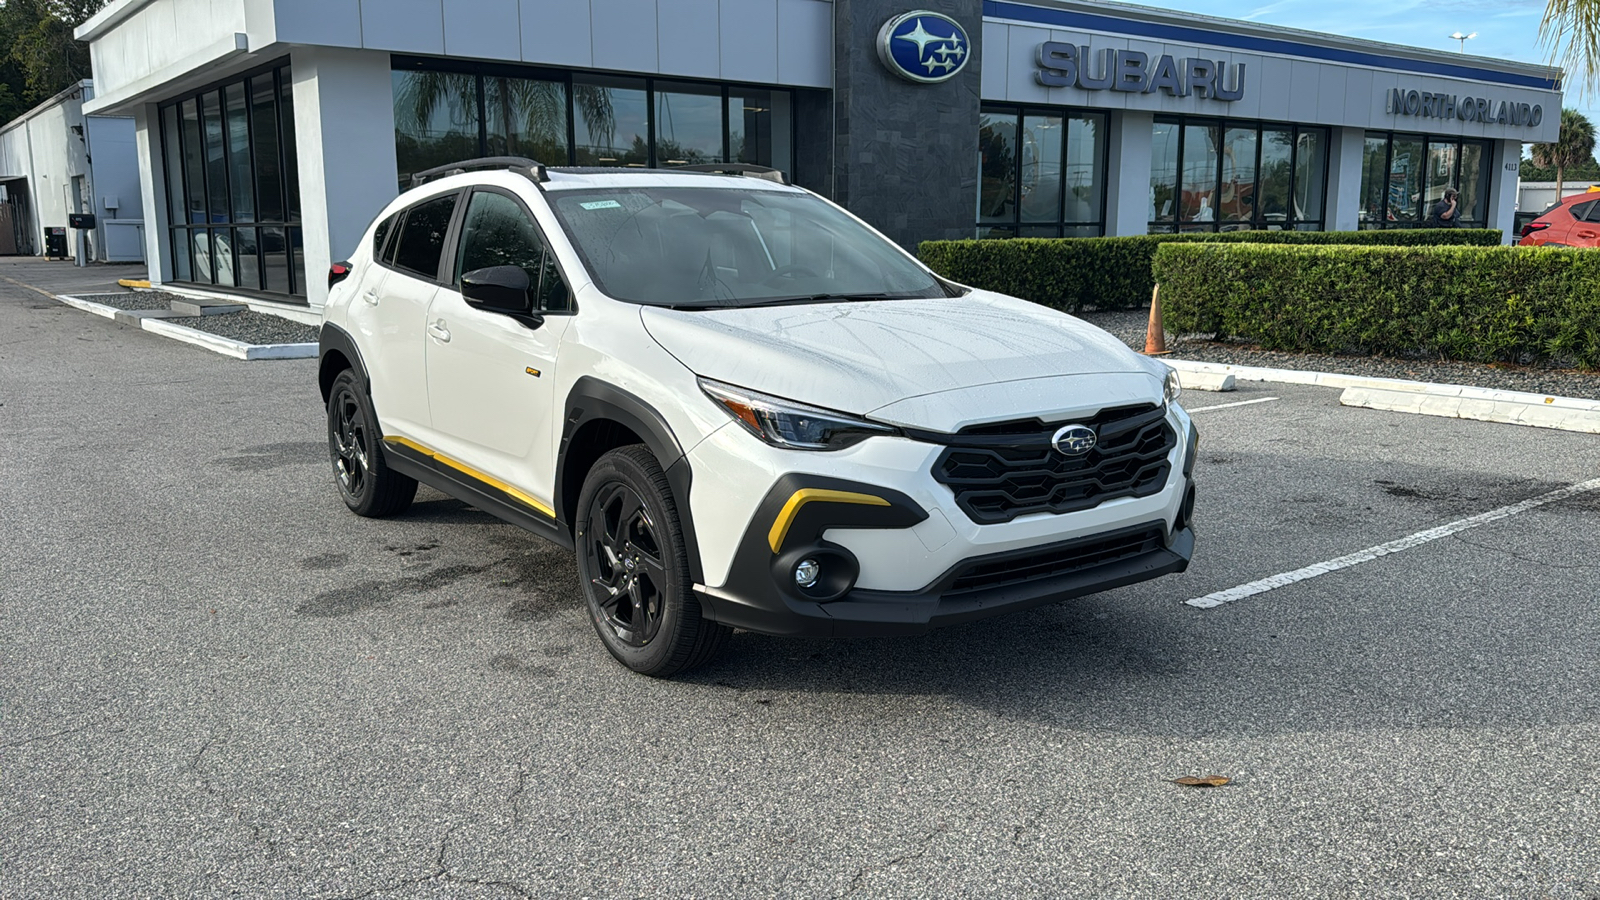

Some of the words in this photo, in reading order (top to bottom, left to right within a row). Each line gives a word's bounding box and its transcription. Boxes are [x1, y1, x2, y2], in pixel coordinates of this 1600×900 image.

[1035, 40, 1246, 101] SUBARU
[1388, 87, 1457, 120] NORTH
[1457, 96, 1543, 127] ORLANDO
